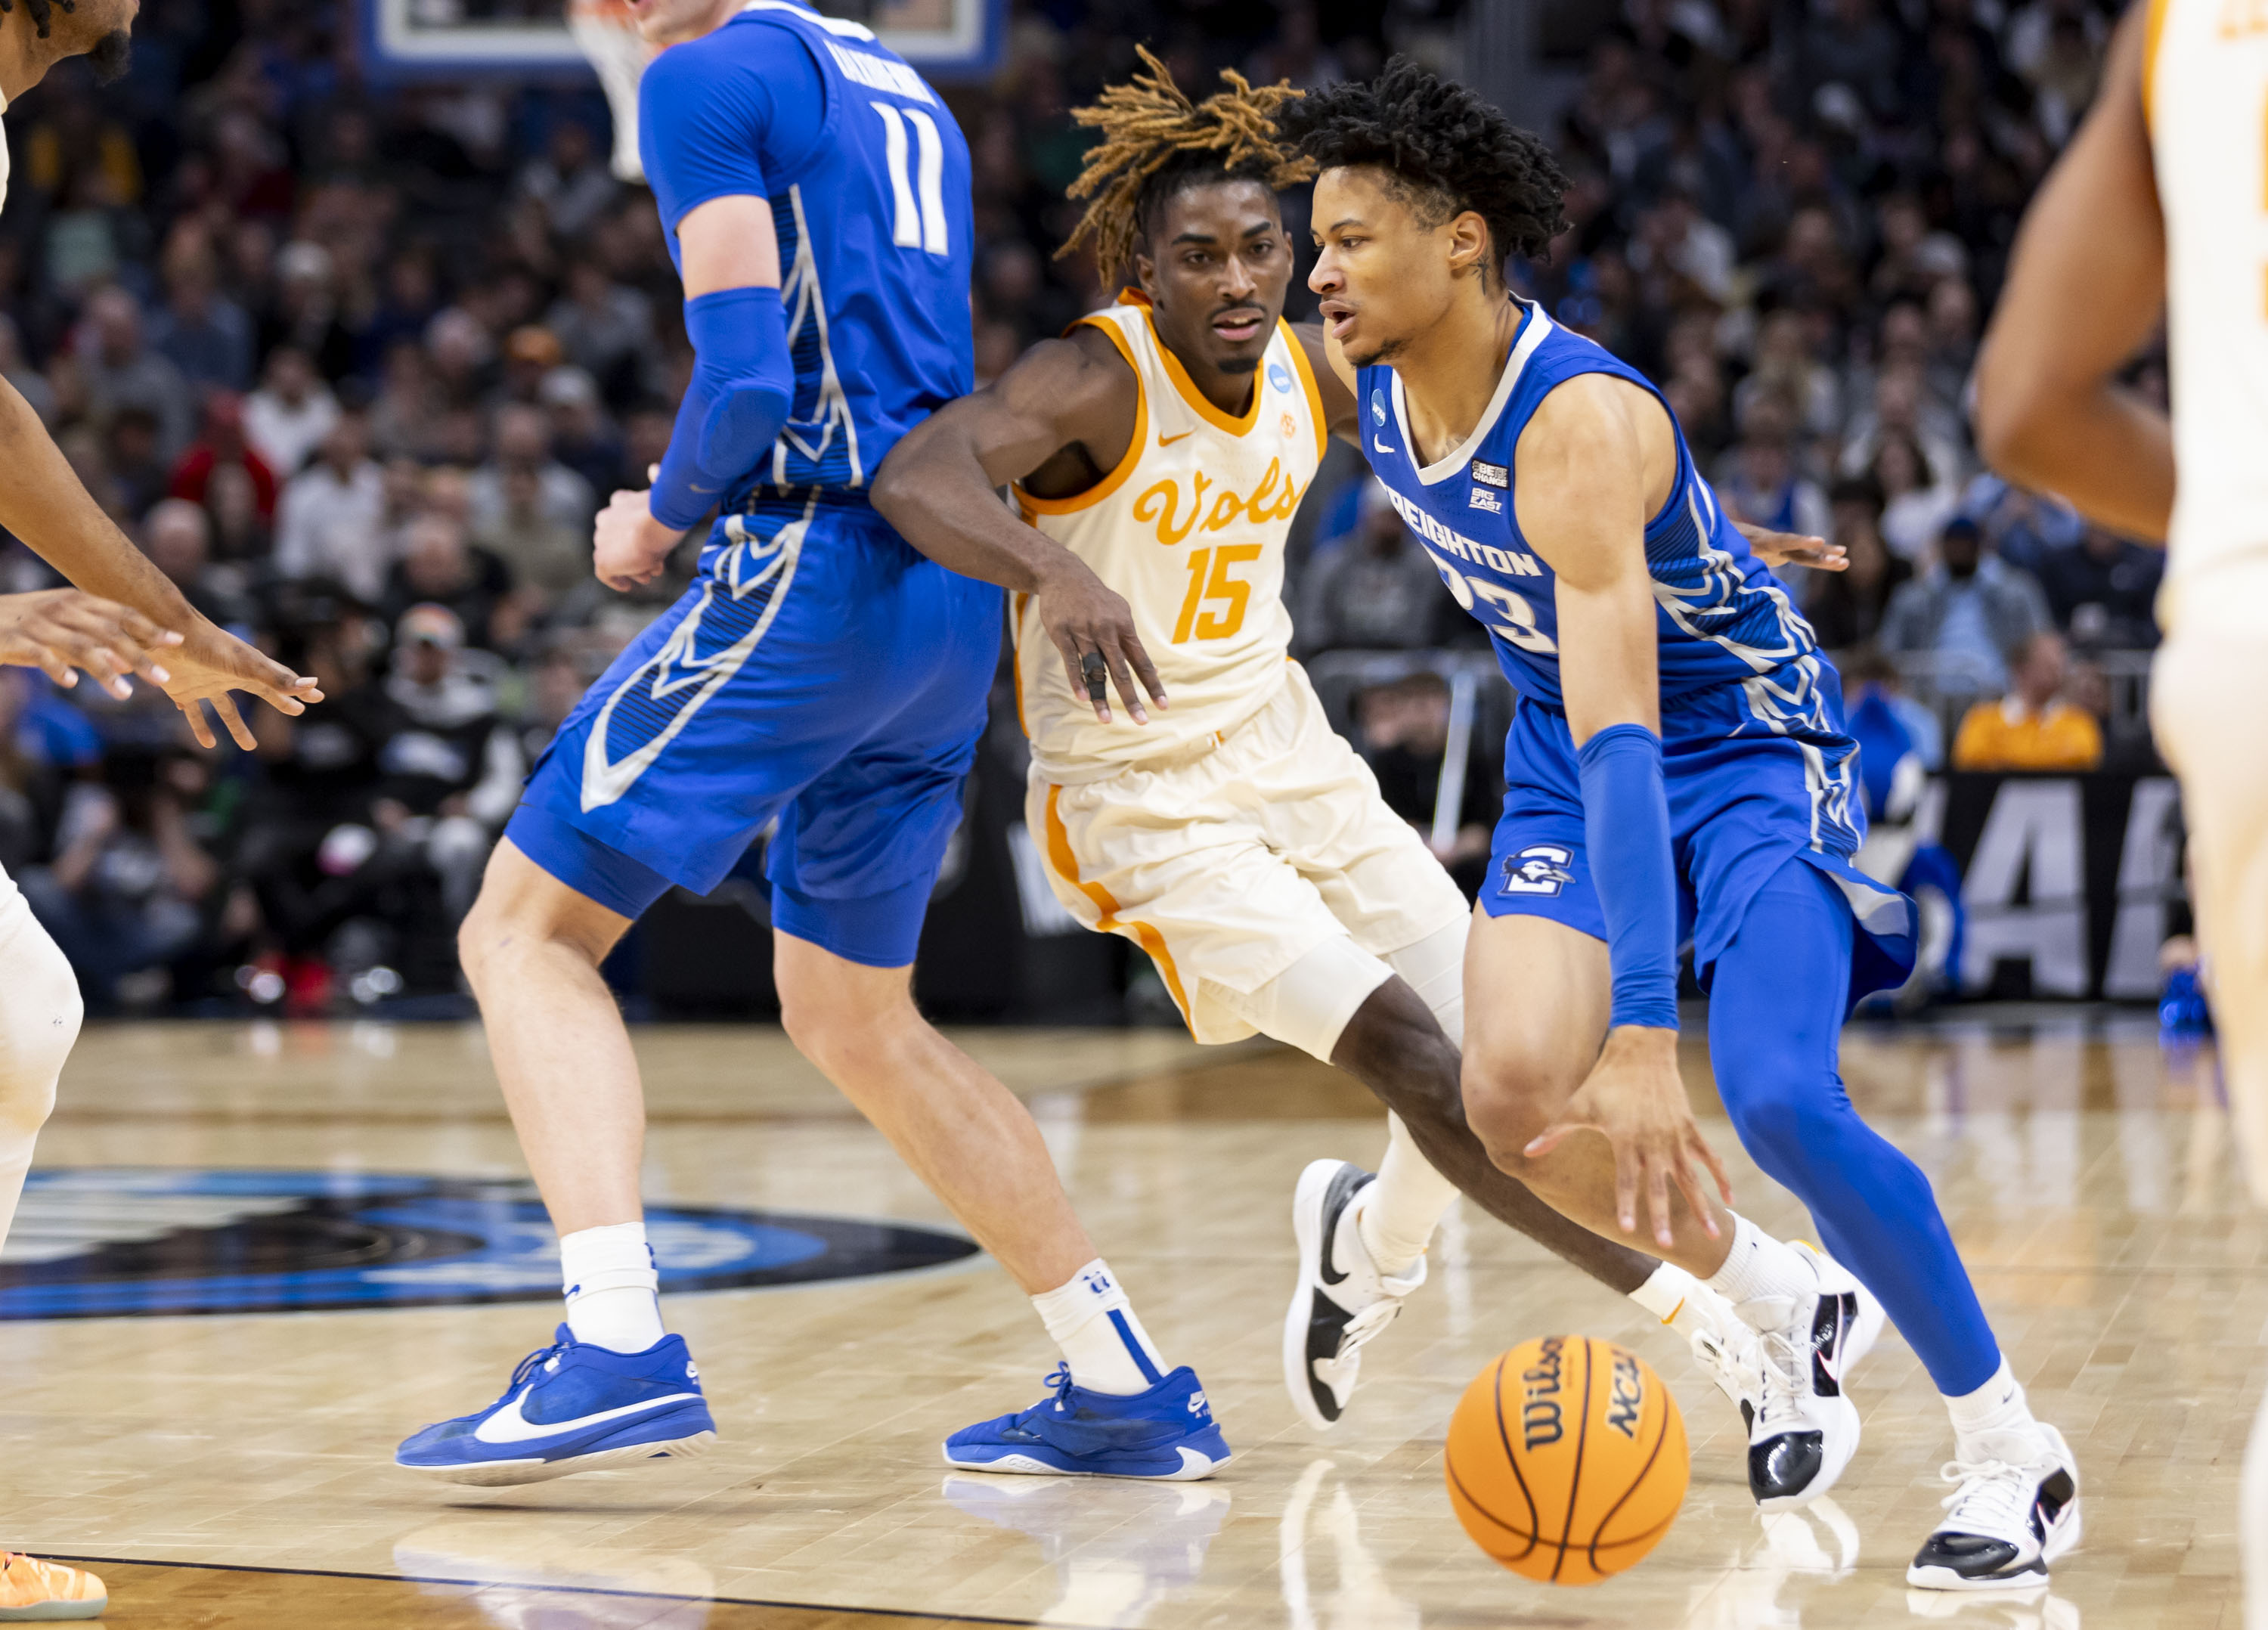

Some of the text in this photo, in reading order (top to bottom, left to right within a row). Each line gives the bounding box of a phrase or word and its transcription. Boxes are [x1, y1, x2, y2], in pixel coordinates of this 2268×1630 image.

[869, 101, 949, 257] 11
[1132, 456, 1309, 545] Vols
[1470, 495, 1502, 511] EAST
[1471, 487, 1495, 501] BIG
[1472, 471, 1507, 488] CHANGE
[1479, 463, 1495, 476] BE
[1375, 475, 1543, 577] REIGHTON
[1171, 544, 1263, 644] 15
[1523, 1337, 1564, 1452] Wilso
[1608, 1348, 1641, 1439] NCA
